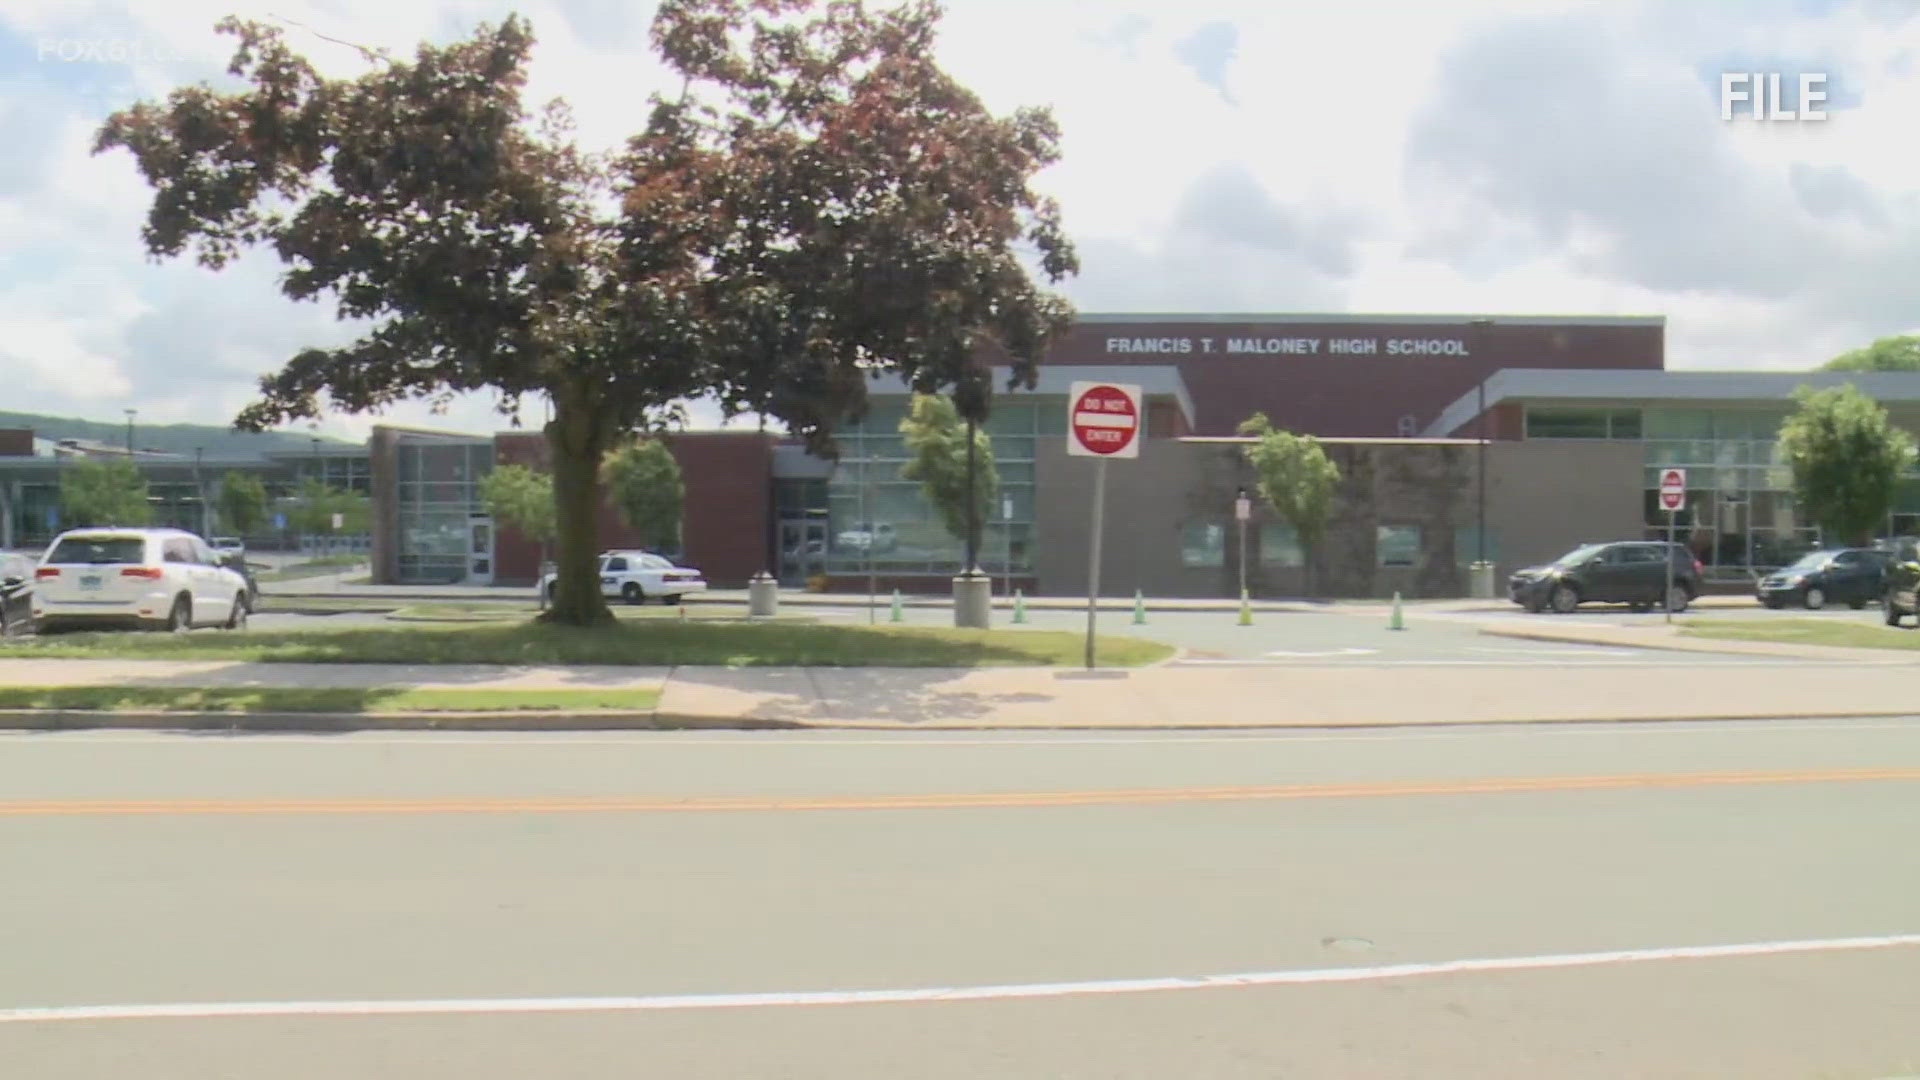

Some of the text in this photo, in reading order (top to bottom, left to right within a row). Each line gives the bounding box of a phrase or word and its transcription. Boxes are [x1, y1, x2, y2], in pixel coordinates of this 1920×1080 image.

[1106, 337, 1470, 355] FRANCIS T. MALONEY HIGH SCHOOL
[1083, 398, 1126, 411] DO NOT
[1086, 429, 1121, 442] ENTER
